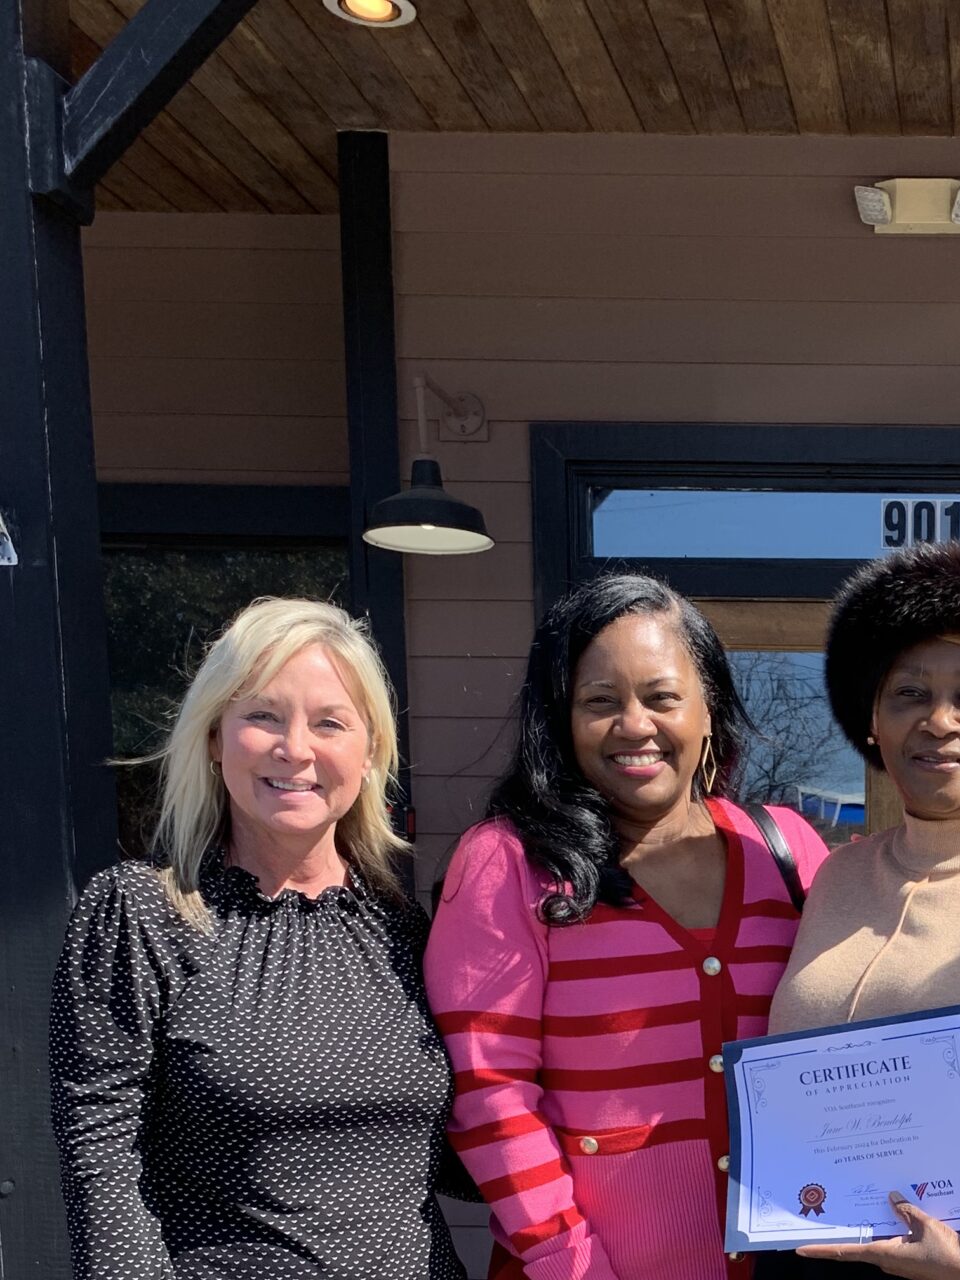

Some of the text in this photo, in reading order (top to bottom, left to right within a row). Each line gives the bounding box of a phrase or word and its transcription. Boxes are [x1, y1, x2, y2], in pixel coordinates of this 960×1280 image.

[799, 1056, 911, 1086] CERTIFICATE
[805, 1074, 912, 1097] OF APPRECIATION
[844, 1153, 865, 1164] YEARS
[876, 1149, 904, 1159] SERVICE
[930, 1179, 953, 1190] VOA
[926, 1189, 955, 1198] Southeast
